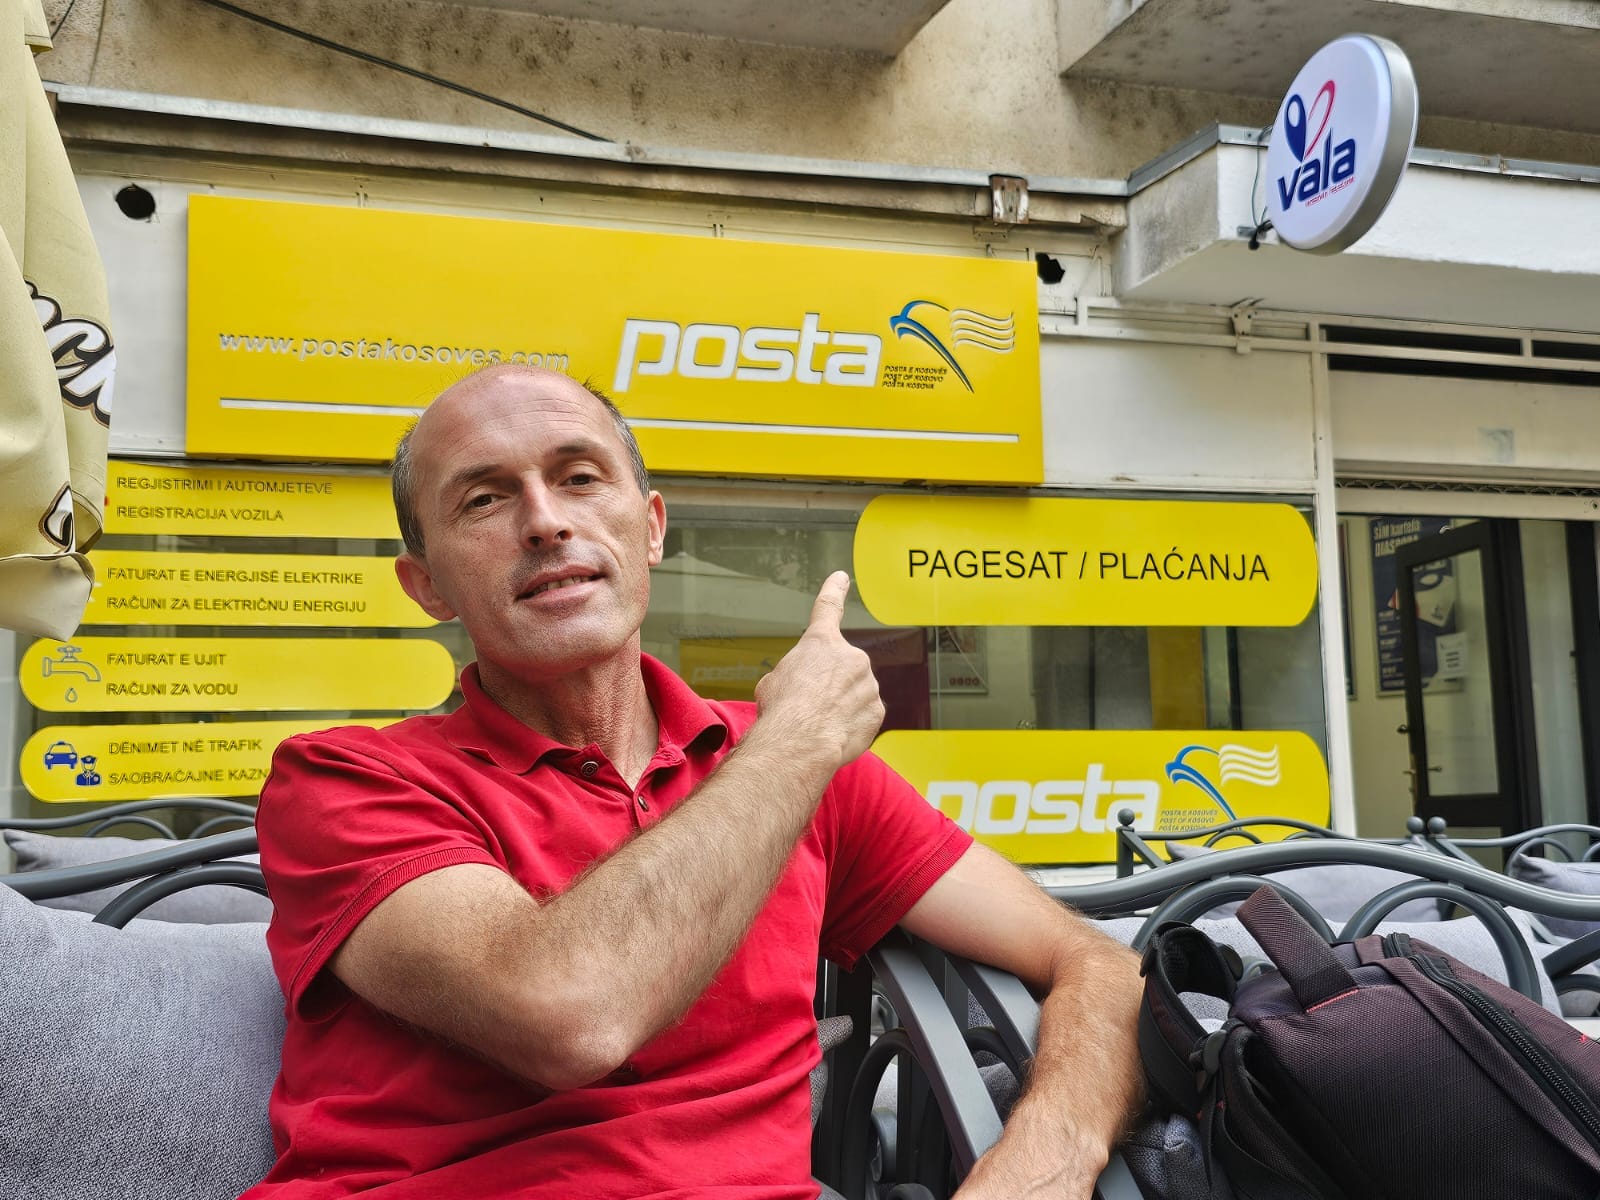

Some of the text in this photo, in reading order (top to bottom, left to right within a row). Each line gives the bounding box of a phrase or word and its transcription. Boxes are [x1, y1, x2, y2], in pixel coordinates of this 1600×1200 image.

[1278, 128, 1356, 211] vala
[219, 332, 570, 370] www.postakosoves.com
[612, 312, 883, 393] posta
[117, 477, 333, 495] REGJISTRIMI I AUTOMJETEVE
[117, 506, 284, 521] REGISTRACIJA VOZILA
[908, 546, 1270, 582] PAGESAT / PLAĆANJA
[107, 568, 363, 585] FATURAT E ENERGJISË ELEKTRIKE
[106, 595, 367, 613] RAČUNI ZA ELEKTRIČNU ENERGIJU
[107, 653, 227, 666] FATURAT E UJIT
[106, 680, 239, 696] RAČUNI ZA VODU
[109, 739, 262, 755] DËNIMET NË TRAFIK
[108, 768, 268, 785] SAOBRAČAJNE KAZN
[924, 763, 1161, 834] posta
